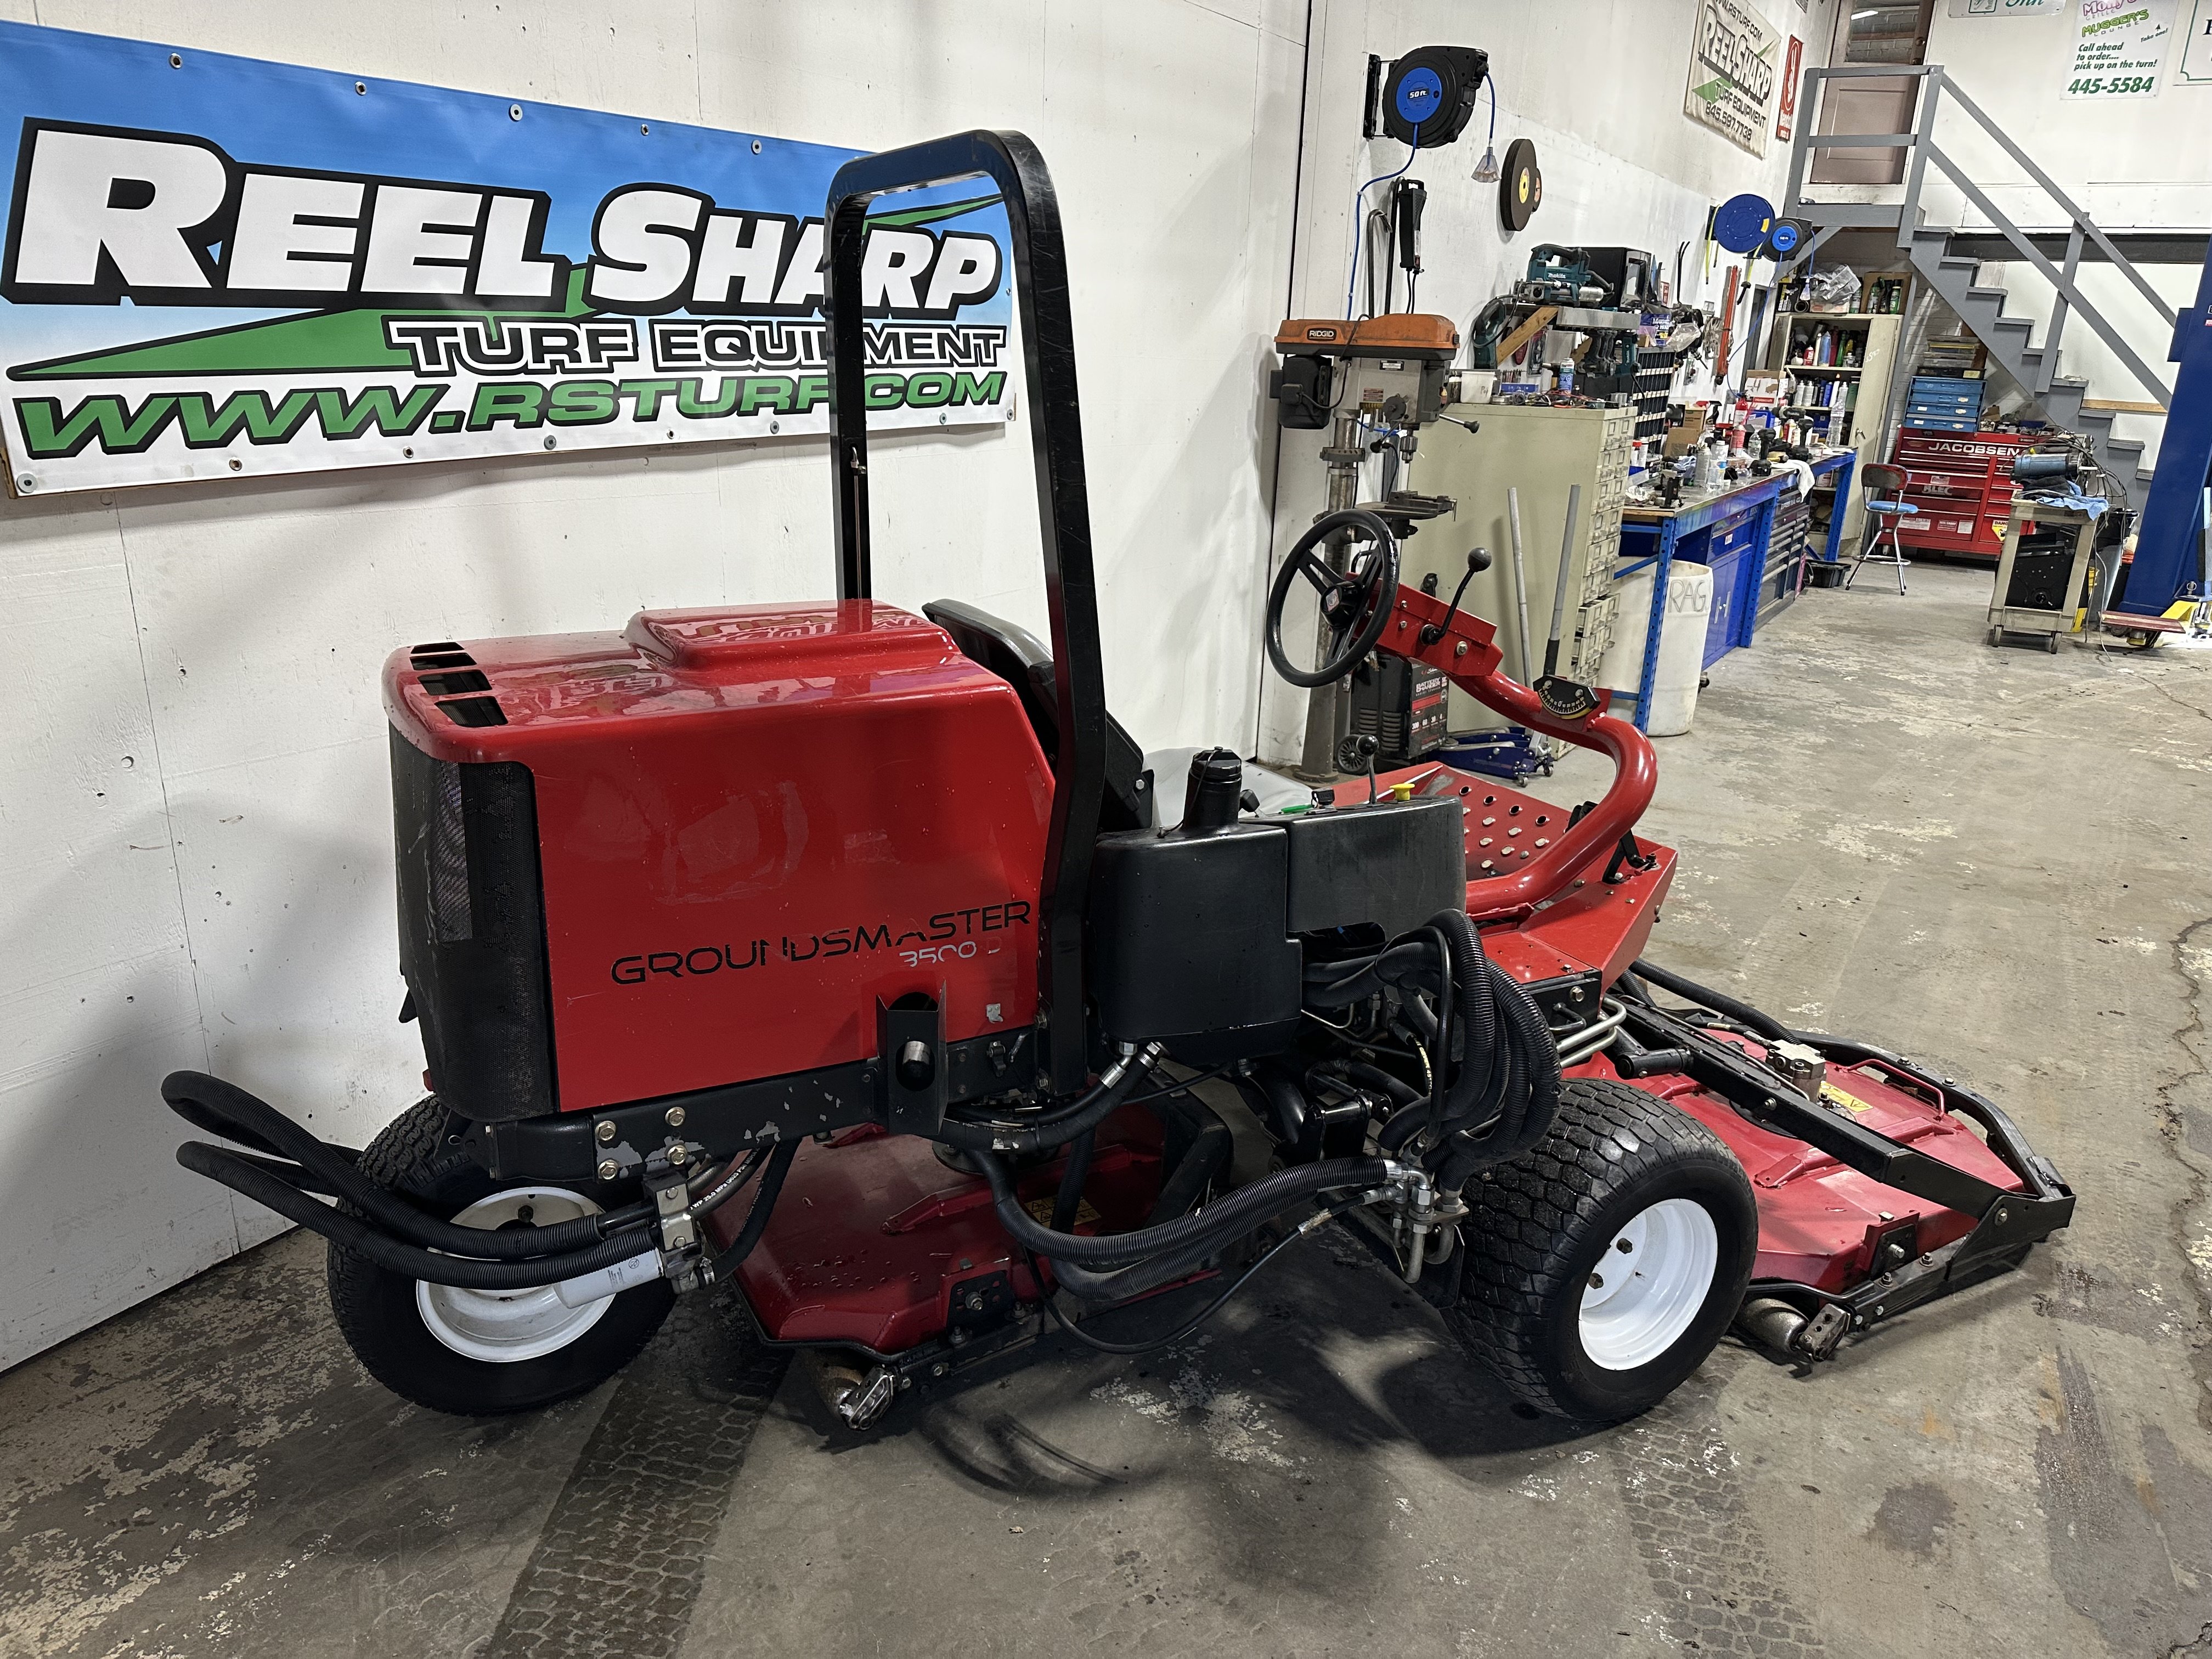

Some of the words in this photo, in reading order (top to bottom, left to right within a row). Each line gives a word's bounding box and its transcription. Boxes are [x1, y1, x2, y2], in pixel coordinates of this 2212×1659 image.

[2081, 9, 2149, 37] MUGGER'S
[1699, 4, 1735, 79] REEL
[1732, 34, 1772, 104] SHARP
[2074, 61, 2091, 71] pick
[2094, 61, 2104, 70] up
[2119, 60, 2134, 68] the
[2135, 59, 2158, 68] turn!
[2078, 43, 2095, 52] Call
[2096, 42, 2124, 52] ahead
[2067, 77, 2155, 94] 445-5584
[1716, 82, 1733, 105] TURF
[1733, 96, 1767, 128] EQUIPMENT
[9, 123, 563, 303] REEL
[384, 316, 637, 376] TURF
[650, 319, 1007, 371] EQUIMENT
[13, 371, 1006, 460] WWW.RSTURFCOM
[1928, 442, 2020, 456] JACOBSEN
